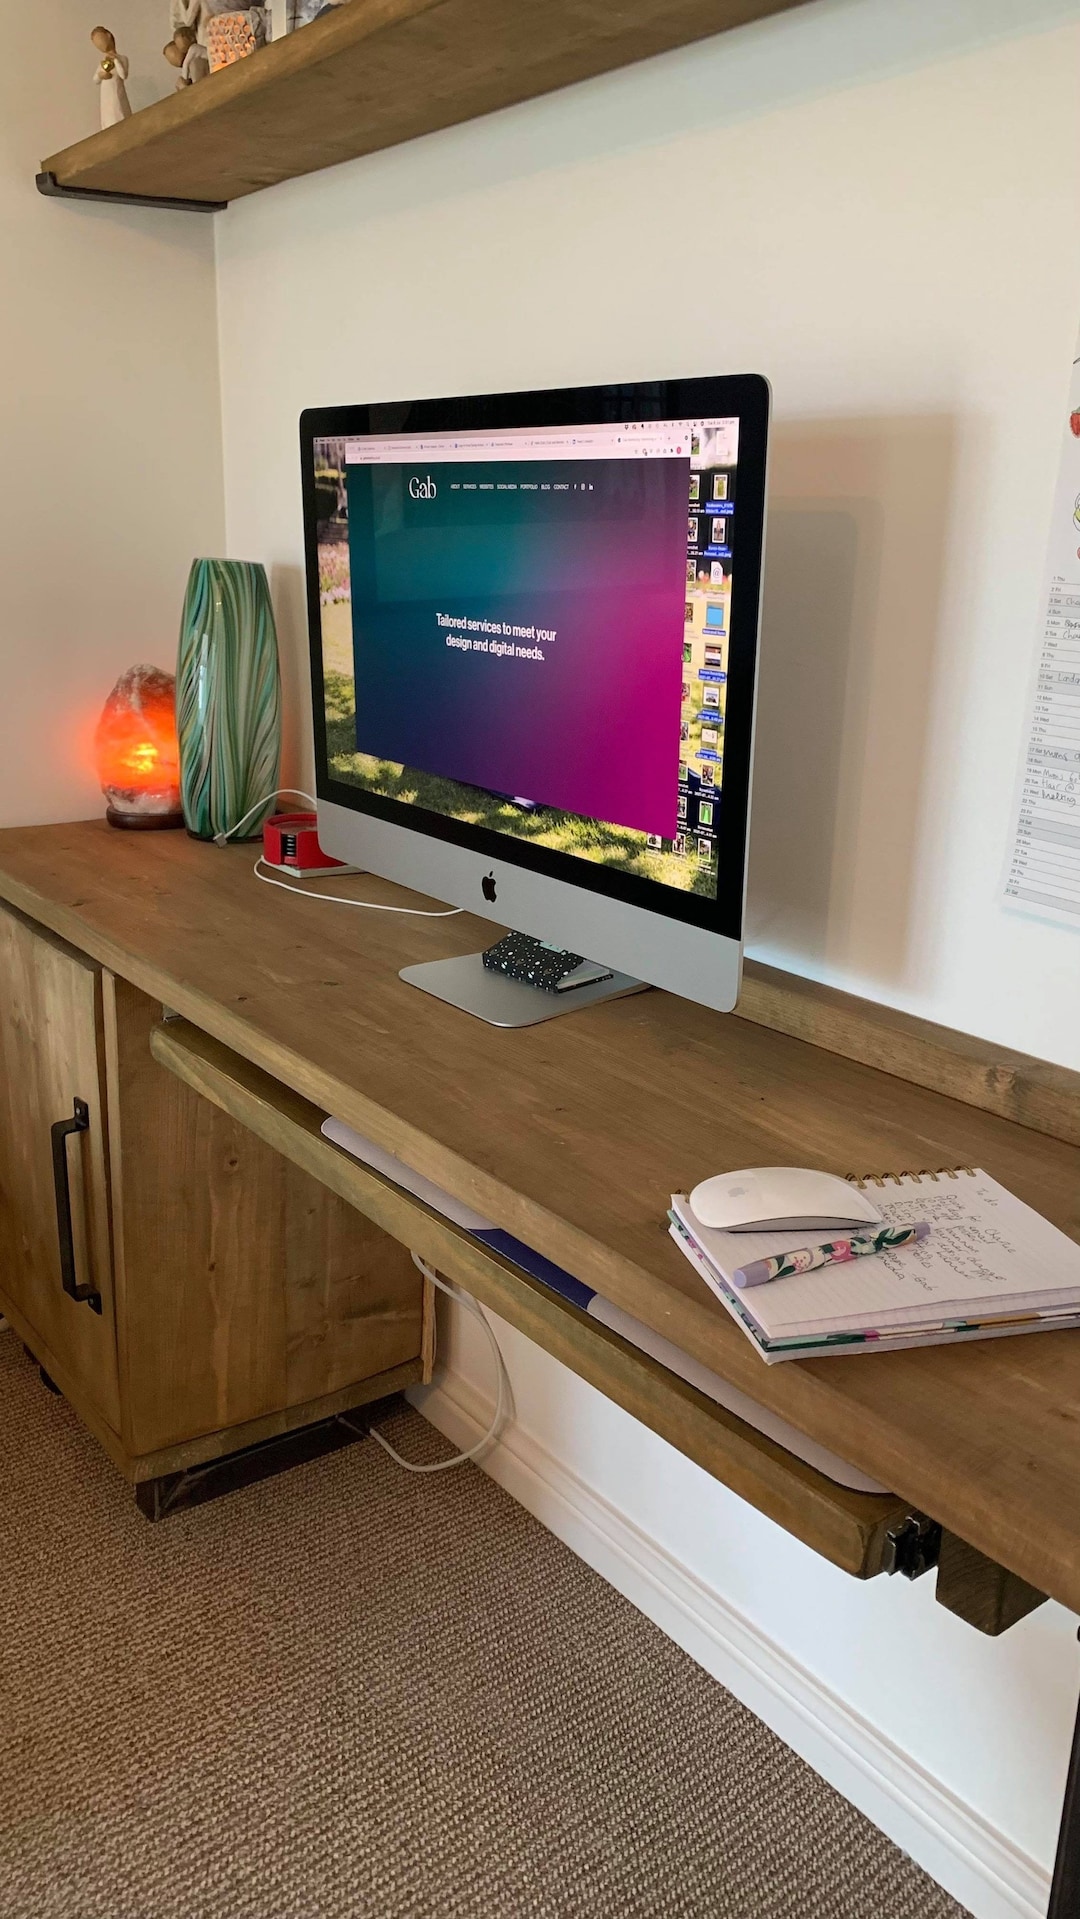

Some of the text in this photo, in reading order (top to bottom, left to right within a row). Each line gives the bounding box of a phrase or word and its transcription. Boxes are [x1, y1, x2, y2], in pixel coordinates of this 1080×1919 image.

[409, 475, 437, 499] Gab
[436, 613, 557, 642] Tailored services to meet your
[446, 634, 545, 660] design and digital needs.
[976, 1187, 999, 1207] To do
